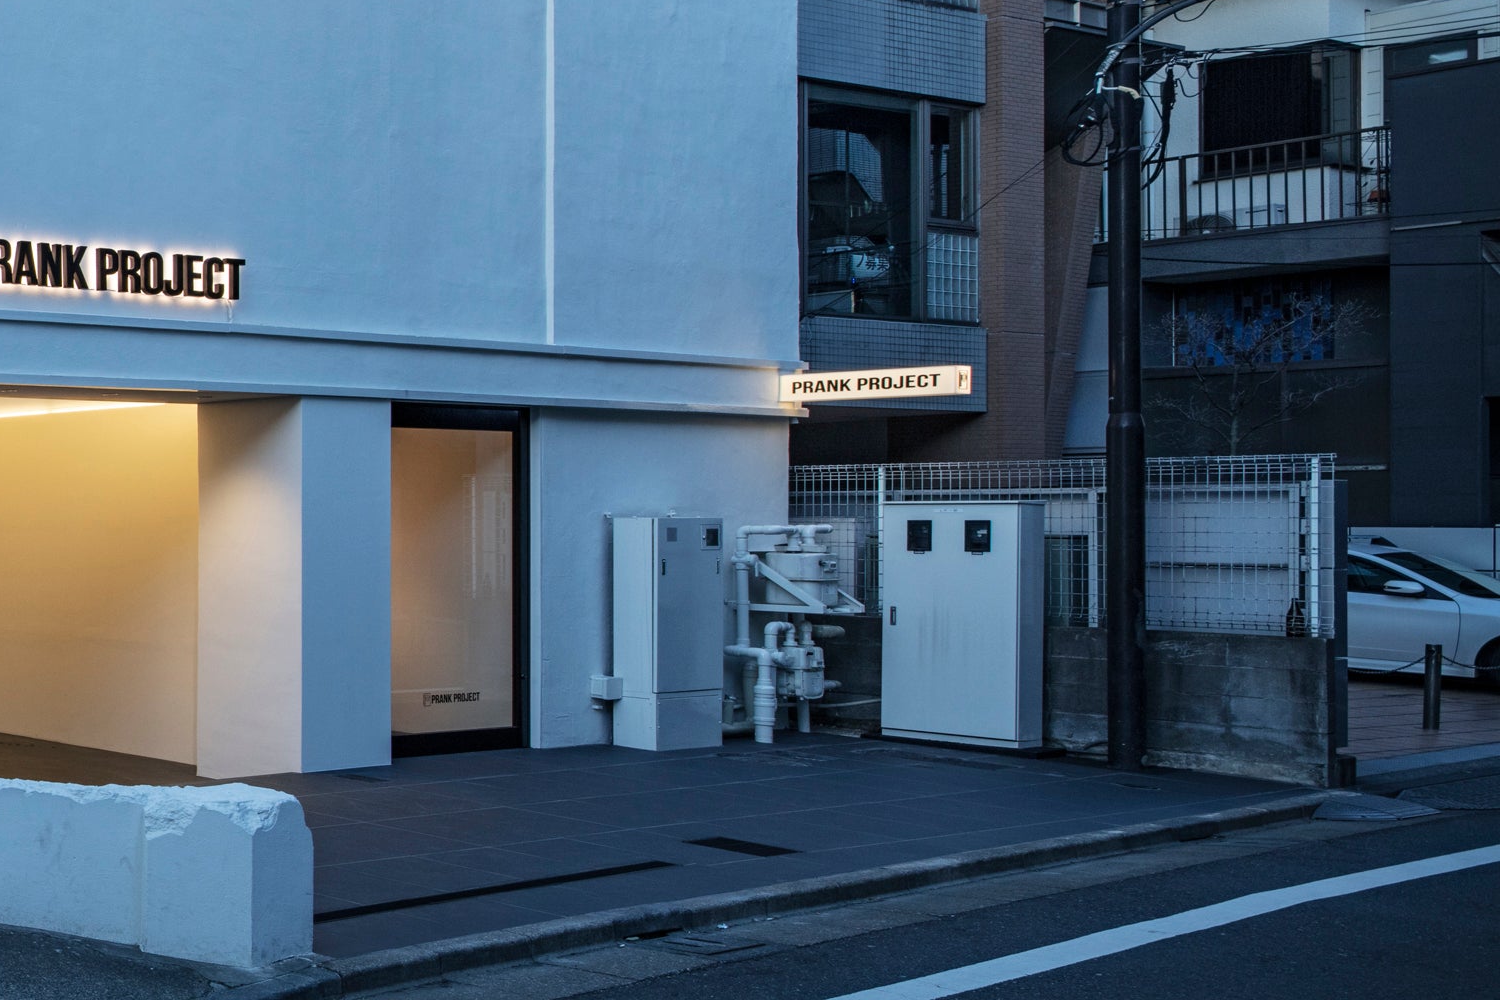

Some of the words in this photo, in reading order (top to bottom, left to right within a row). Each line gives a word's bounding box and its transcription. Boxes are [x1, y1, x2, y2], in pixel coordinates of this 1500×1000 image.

[95, 247, 246, 300] PROJECT
[792, 378, 851, 394] PRANK
[857, 373, 941, 391] PROJECT
[431, 694, 452, 704] PRANK
[453, 692, 481, 703] PROJECT
